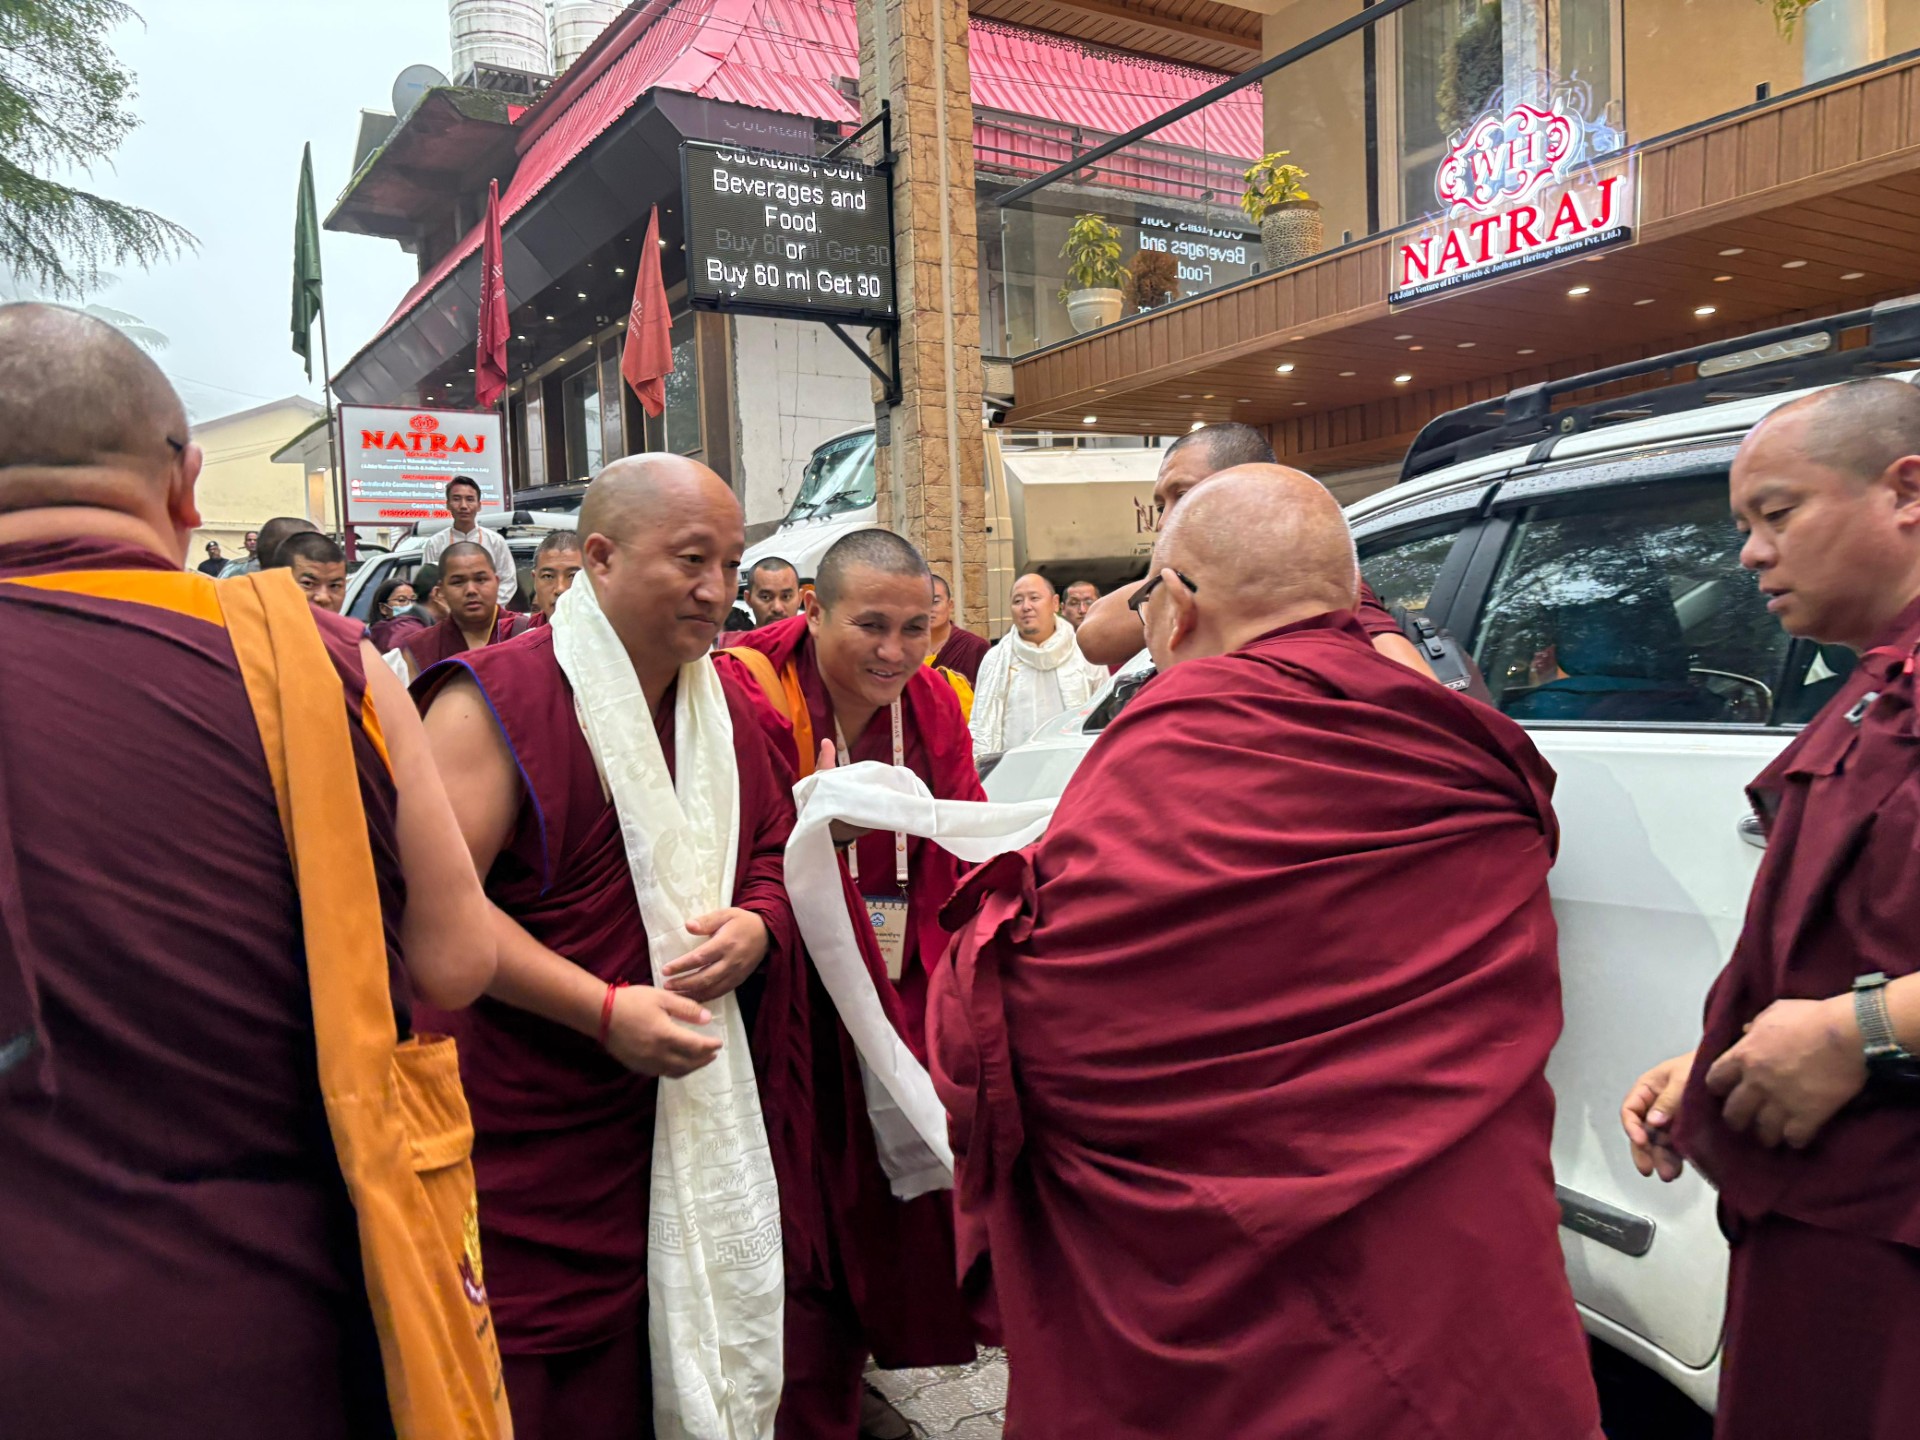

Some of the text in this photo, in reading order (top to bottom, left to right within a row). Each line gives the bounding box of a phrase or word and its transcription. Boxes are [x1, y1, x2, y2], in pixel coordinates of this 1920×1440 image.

[713, 169, 866, 211] Beverages and
[765, 205, 822, 234] Food.
[1400, 174, 1627, 289] NATRAJ
[786, 243, 806, 260] or
[1416, 281, 1440, 294] Venture
[1440, 279, 1448, 288] of
[1447, 275, 1462, 286] ITC
[1462, 268, 1483, 281] Hotels
[1483, 266, 1491, 275] &
[1522, 250, 1554, 265] Heritage
[1554, 241, 1583, 256] Resorts
[1584, 235, 1600, 247] Pvt.
[1600, 228, 1622, 242] Ltd.)
[706, 257, 881, 299] Buy 60 ml Get 30
[360, 430, 487, 454] NATRAJ
